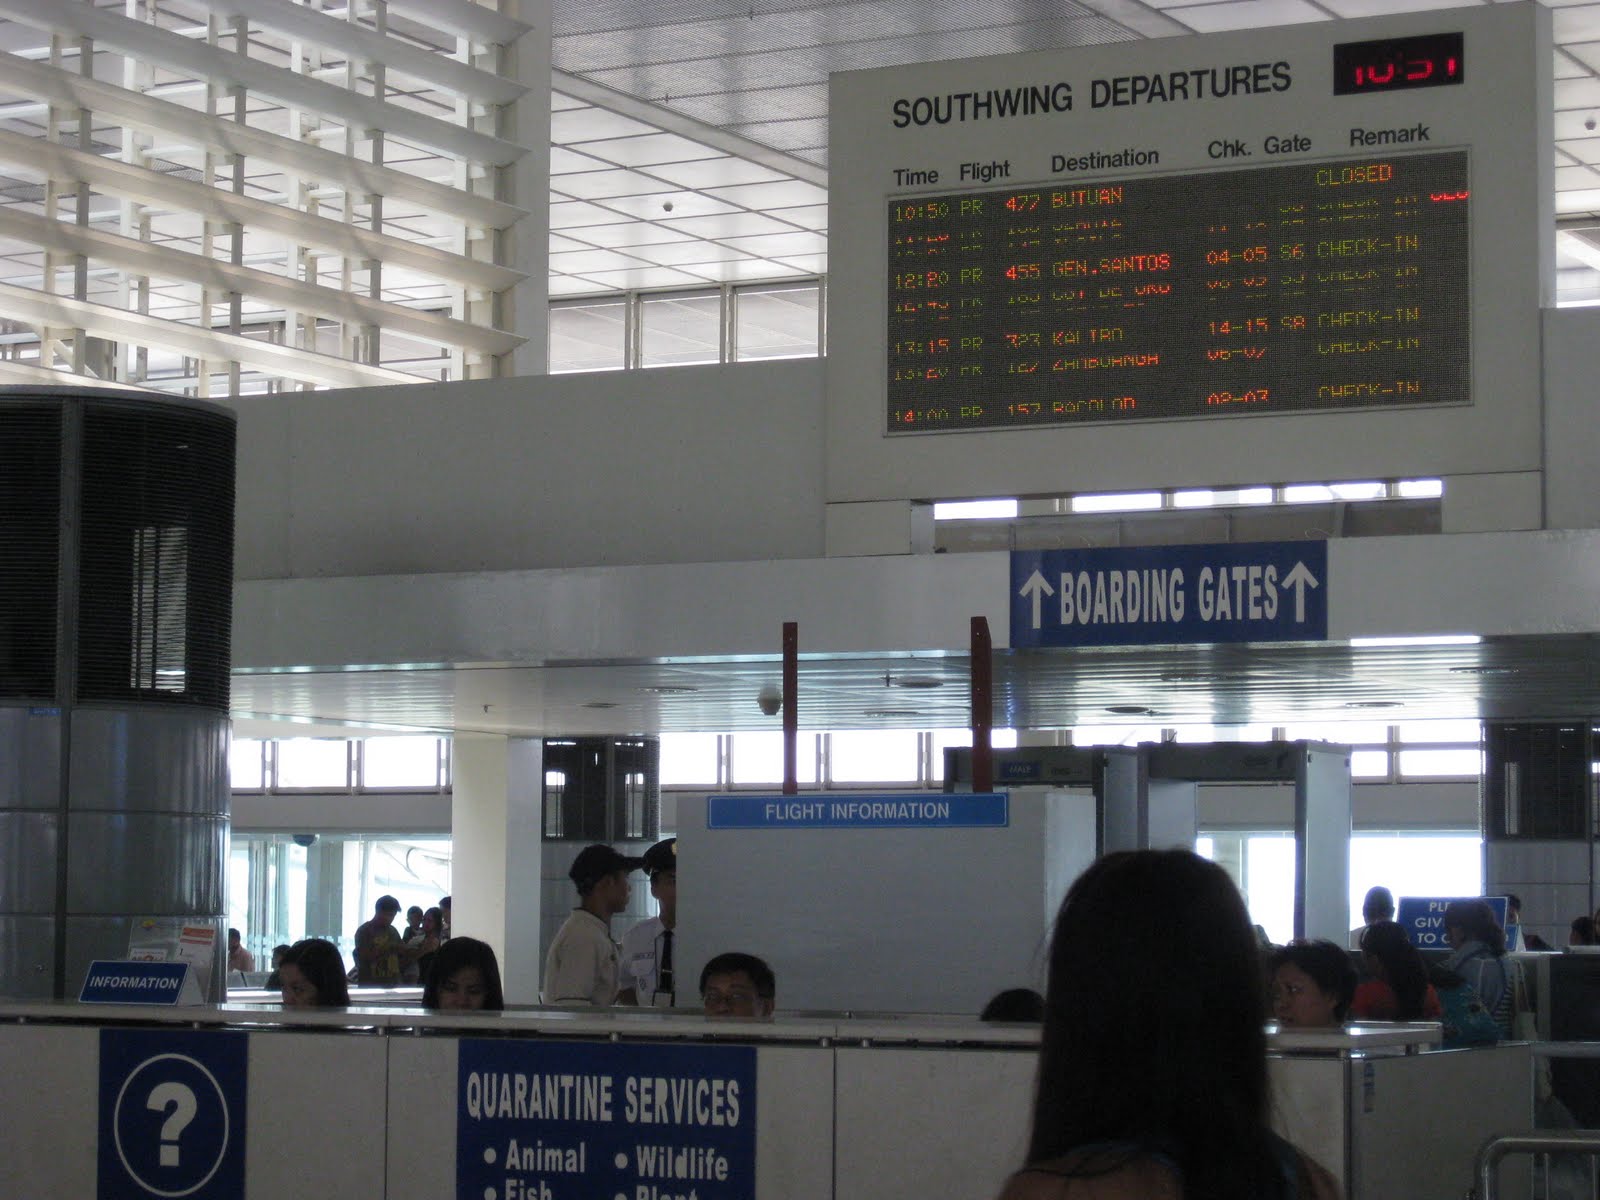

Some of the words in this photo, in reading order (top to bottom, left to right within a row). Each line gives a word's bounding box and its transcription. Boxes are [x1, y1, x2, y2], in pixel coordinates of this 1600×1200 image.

[893, 82, 1073, 128] SOUTHWING
[1091, 61, 1291, 110] DEPARTURES
[894, 169, 939, 186] Time
[960, 160, 1010, 183] Flight
[1052, 147, 1160, 173] Destination
[1208, 140, 1252, 160] Chk.
[1264, 135, 1311, 155] Gate
[1350, 124, 1430, 147] Remark
[896, 203, 949, 222] 10:50
[960, 199, 983, 216] PR
[1006, 194, 1041, 211] 477
[1052, 186, 1123, 208] BUTUAN
[1317, 164, 1392, 186] CLOSED
[896, 270, 949, 289] 12:20
[960, 267, 983, 284] PR
[1006, 263, 1041, 280] 455
[1206, 246, 1268, 265] 04-05
[1318, 234, 1419, 258] CHECK-IN
[961, 336, 983, 351] PR
[1208, 317, 1269, 335] 14-15
[1060, 567, 1185, 625] BOARDING
[1199, 564, 1278, 622] GATES
[765, 802, 824, 821] FLIGHT
[831, 802, 949, 820] INFORMATION
[90, 976, 180, 989] INFORMATION
[467, 1072, 613, 1122] QUARANTINE
[625, 1076, 740, 1127] SERVICES
[506, 1139, 586, 1173] Animal
[636, 1145, 729, 1181] Wildlife
[506, 1179, 552, 1200] Fish
